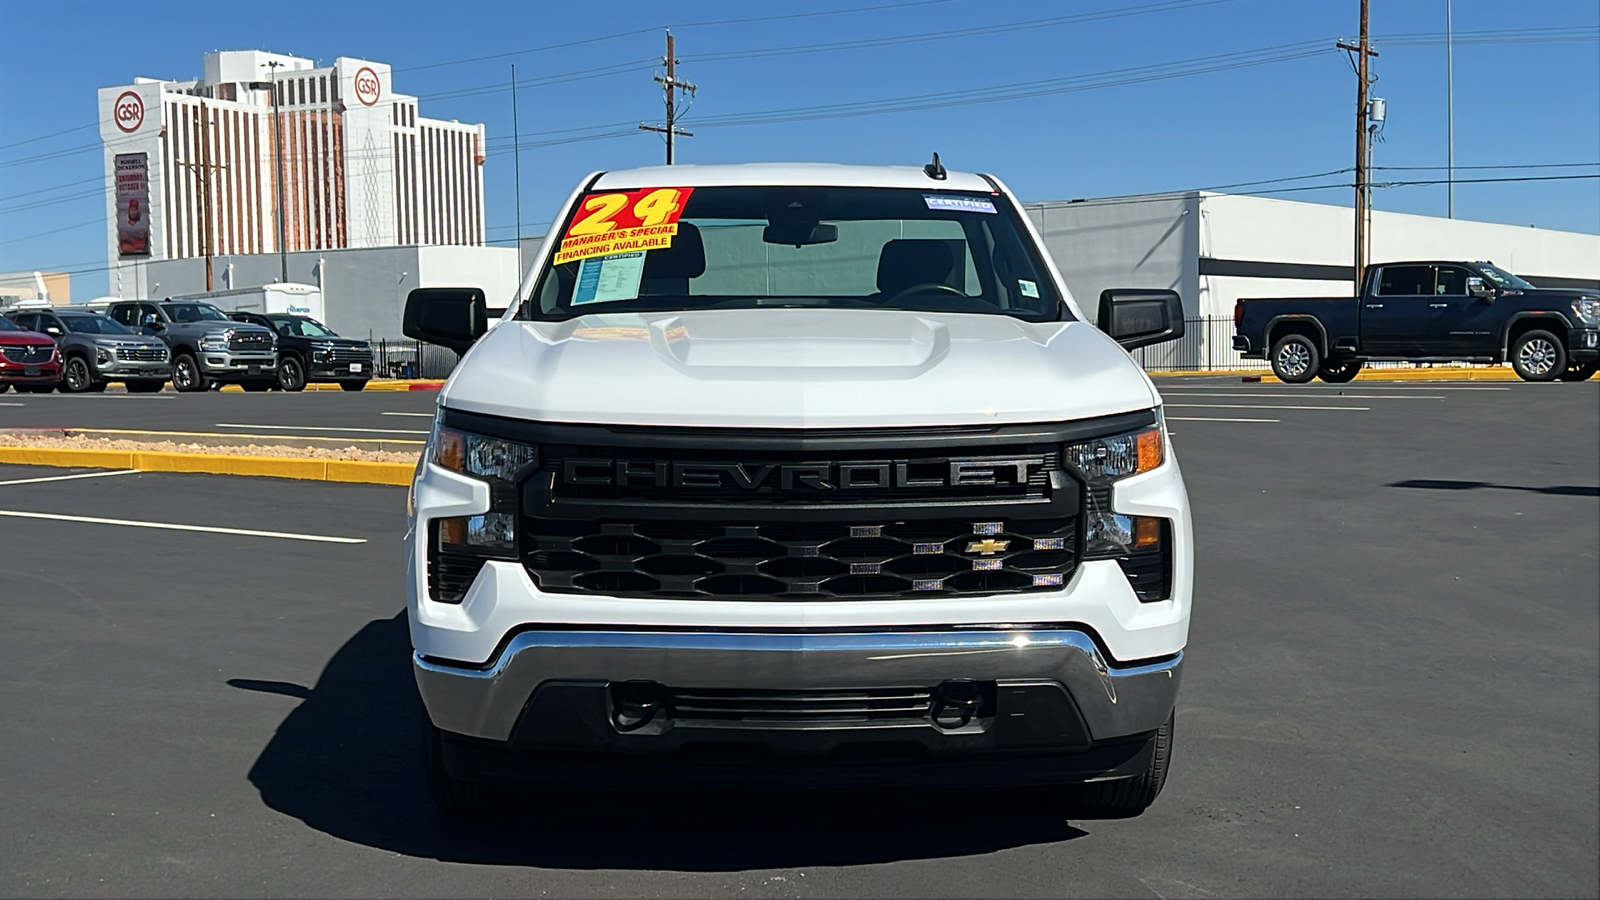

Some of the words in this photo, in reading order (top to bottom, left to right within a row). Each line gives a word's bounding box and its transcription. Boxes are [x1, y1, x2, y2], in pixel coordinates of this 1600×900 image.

[358, 77, 376, 96] GSR
[118, 102, 139, 121] GSR
[569, 188, 681, 236] 24
[928, 198, 991, 209] CERTIFIED
[562, 230, 626, 249] MANAGER'S
[629, 225, 676, 238] SPECIAL
[556, 244, 610, 262] FINANCING
[612, 237, 668, 251] AVAILABLE
[563, 456, 1045, 491] CHEVROLET
